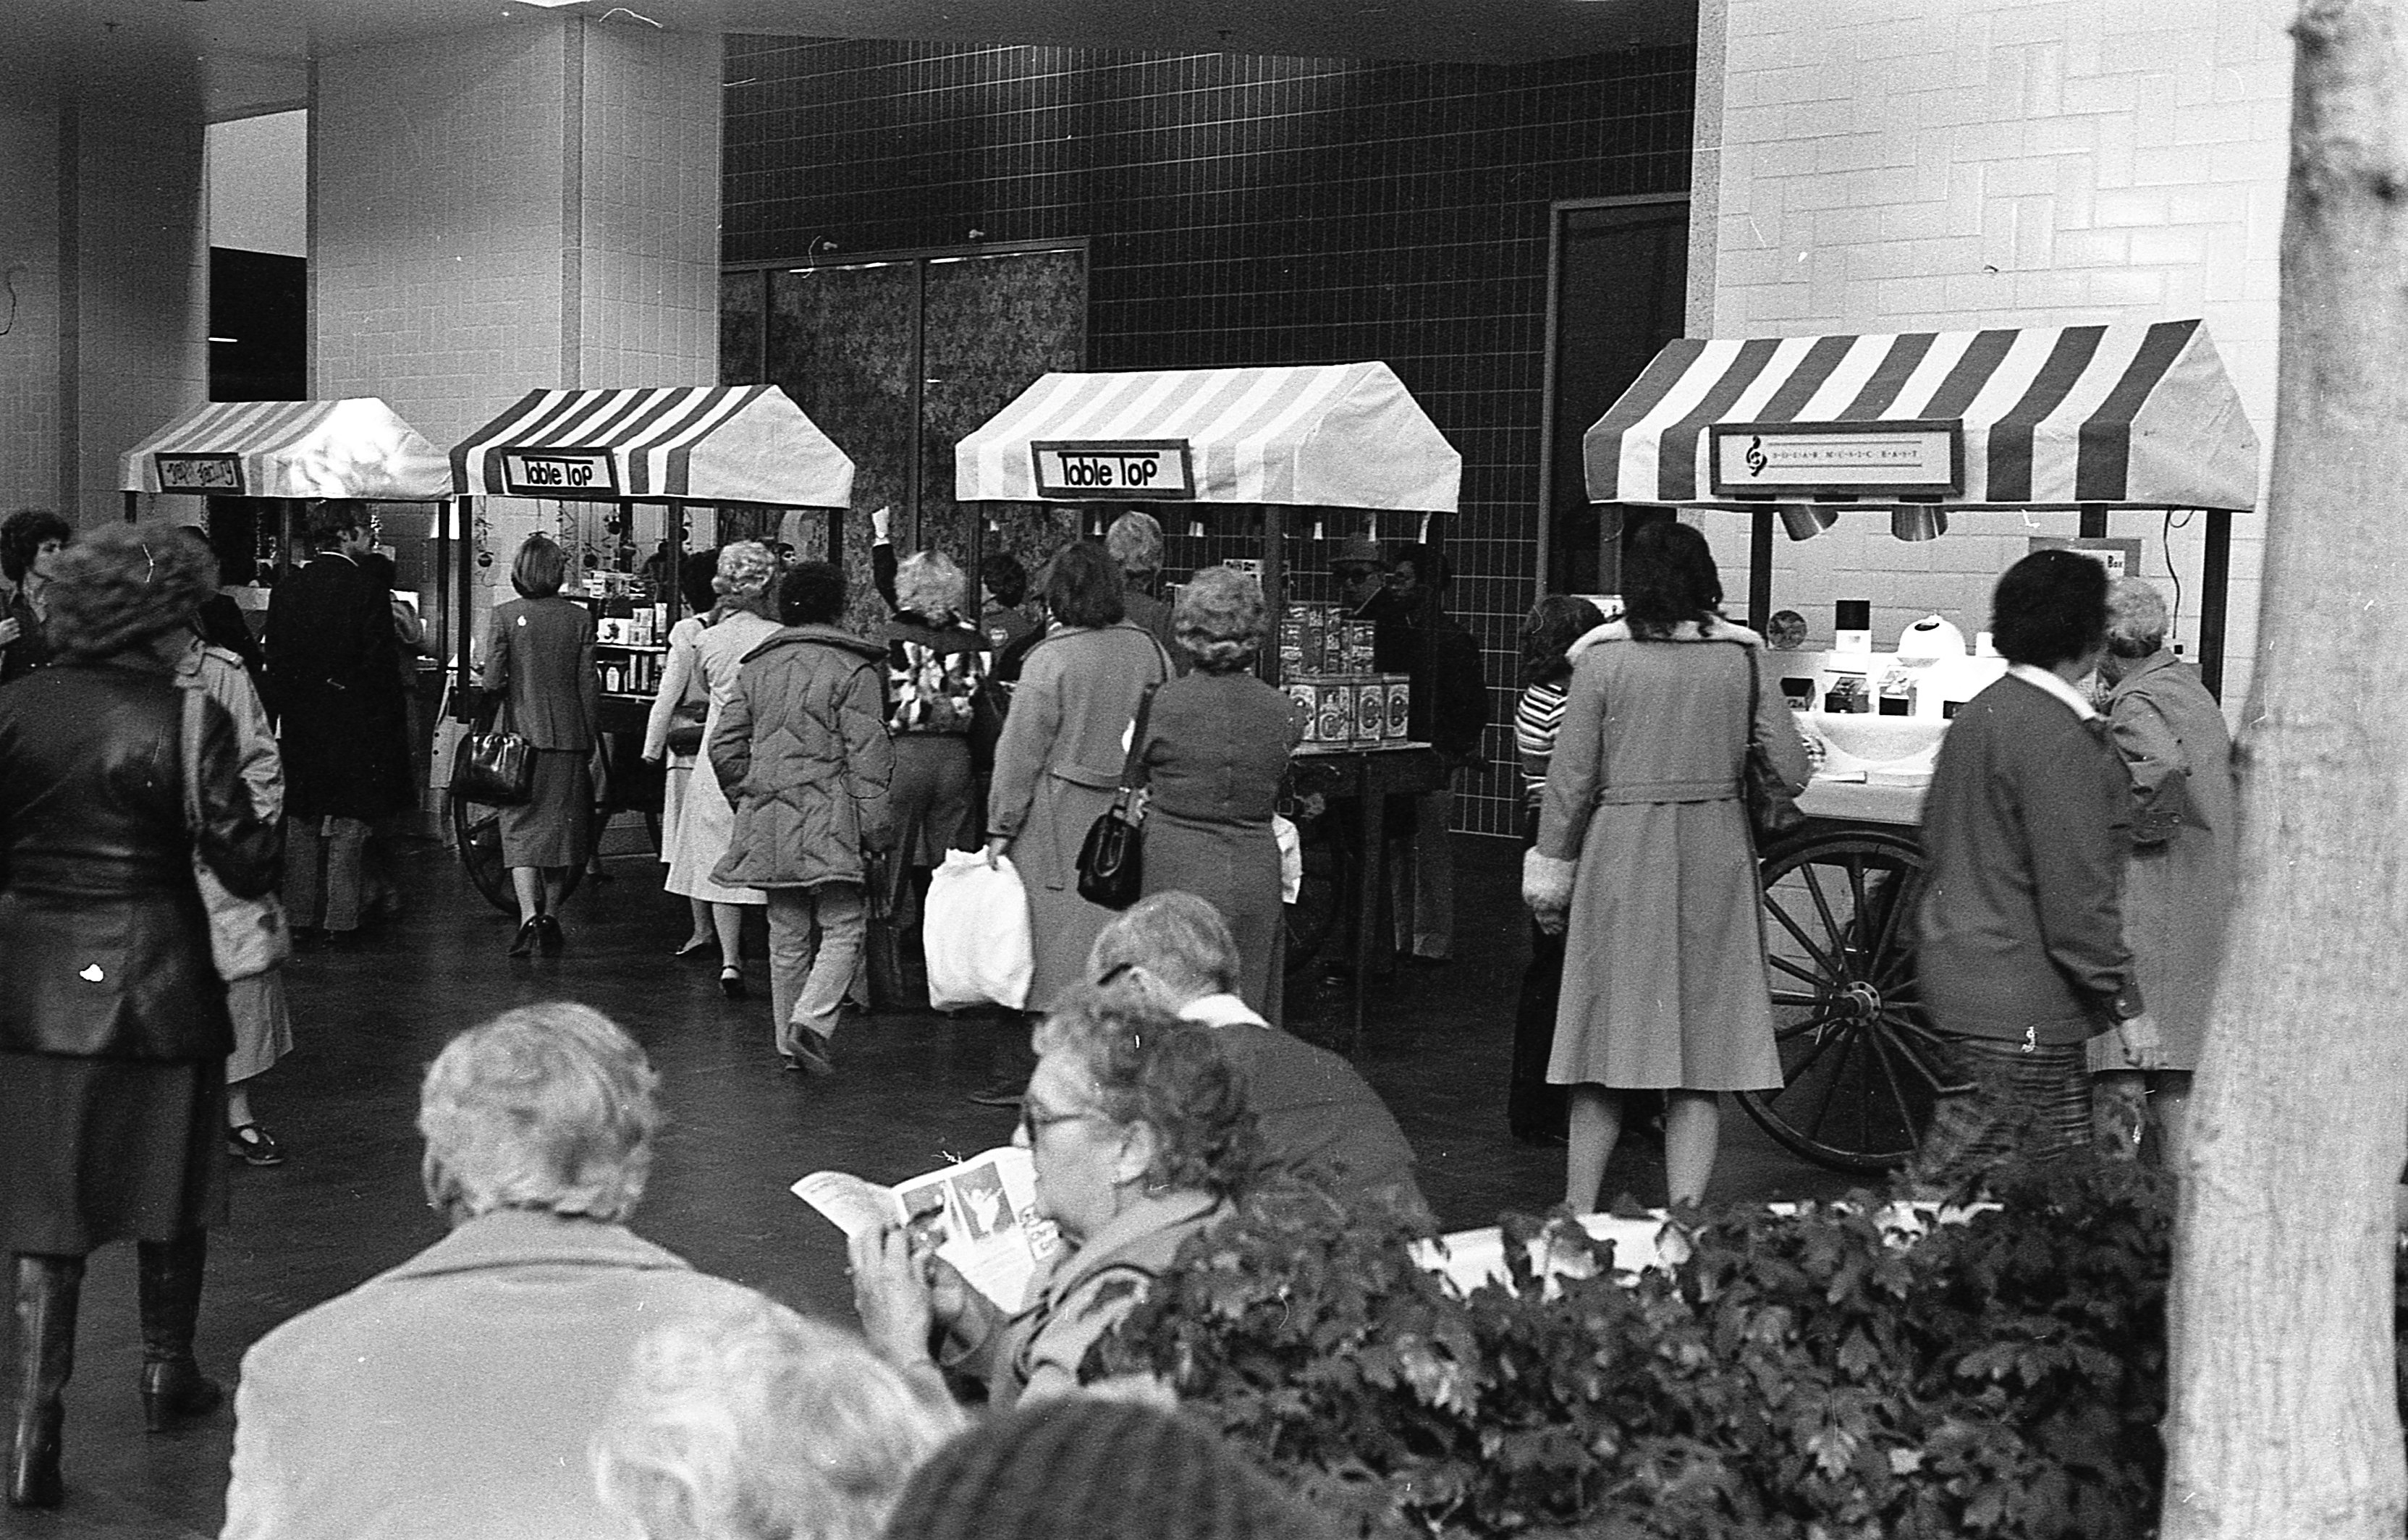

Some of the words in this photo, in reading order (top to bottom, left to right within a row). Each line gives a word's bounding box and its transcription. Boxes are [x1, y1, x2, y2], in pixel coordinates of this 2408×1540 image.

[521, 456, 562, 485] Table
[564, 458, 594, 486] Top
[1057, 452, 1112, 486] Table
[1120, 452, 1160, 486] Top
